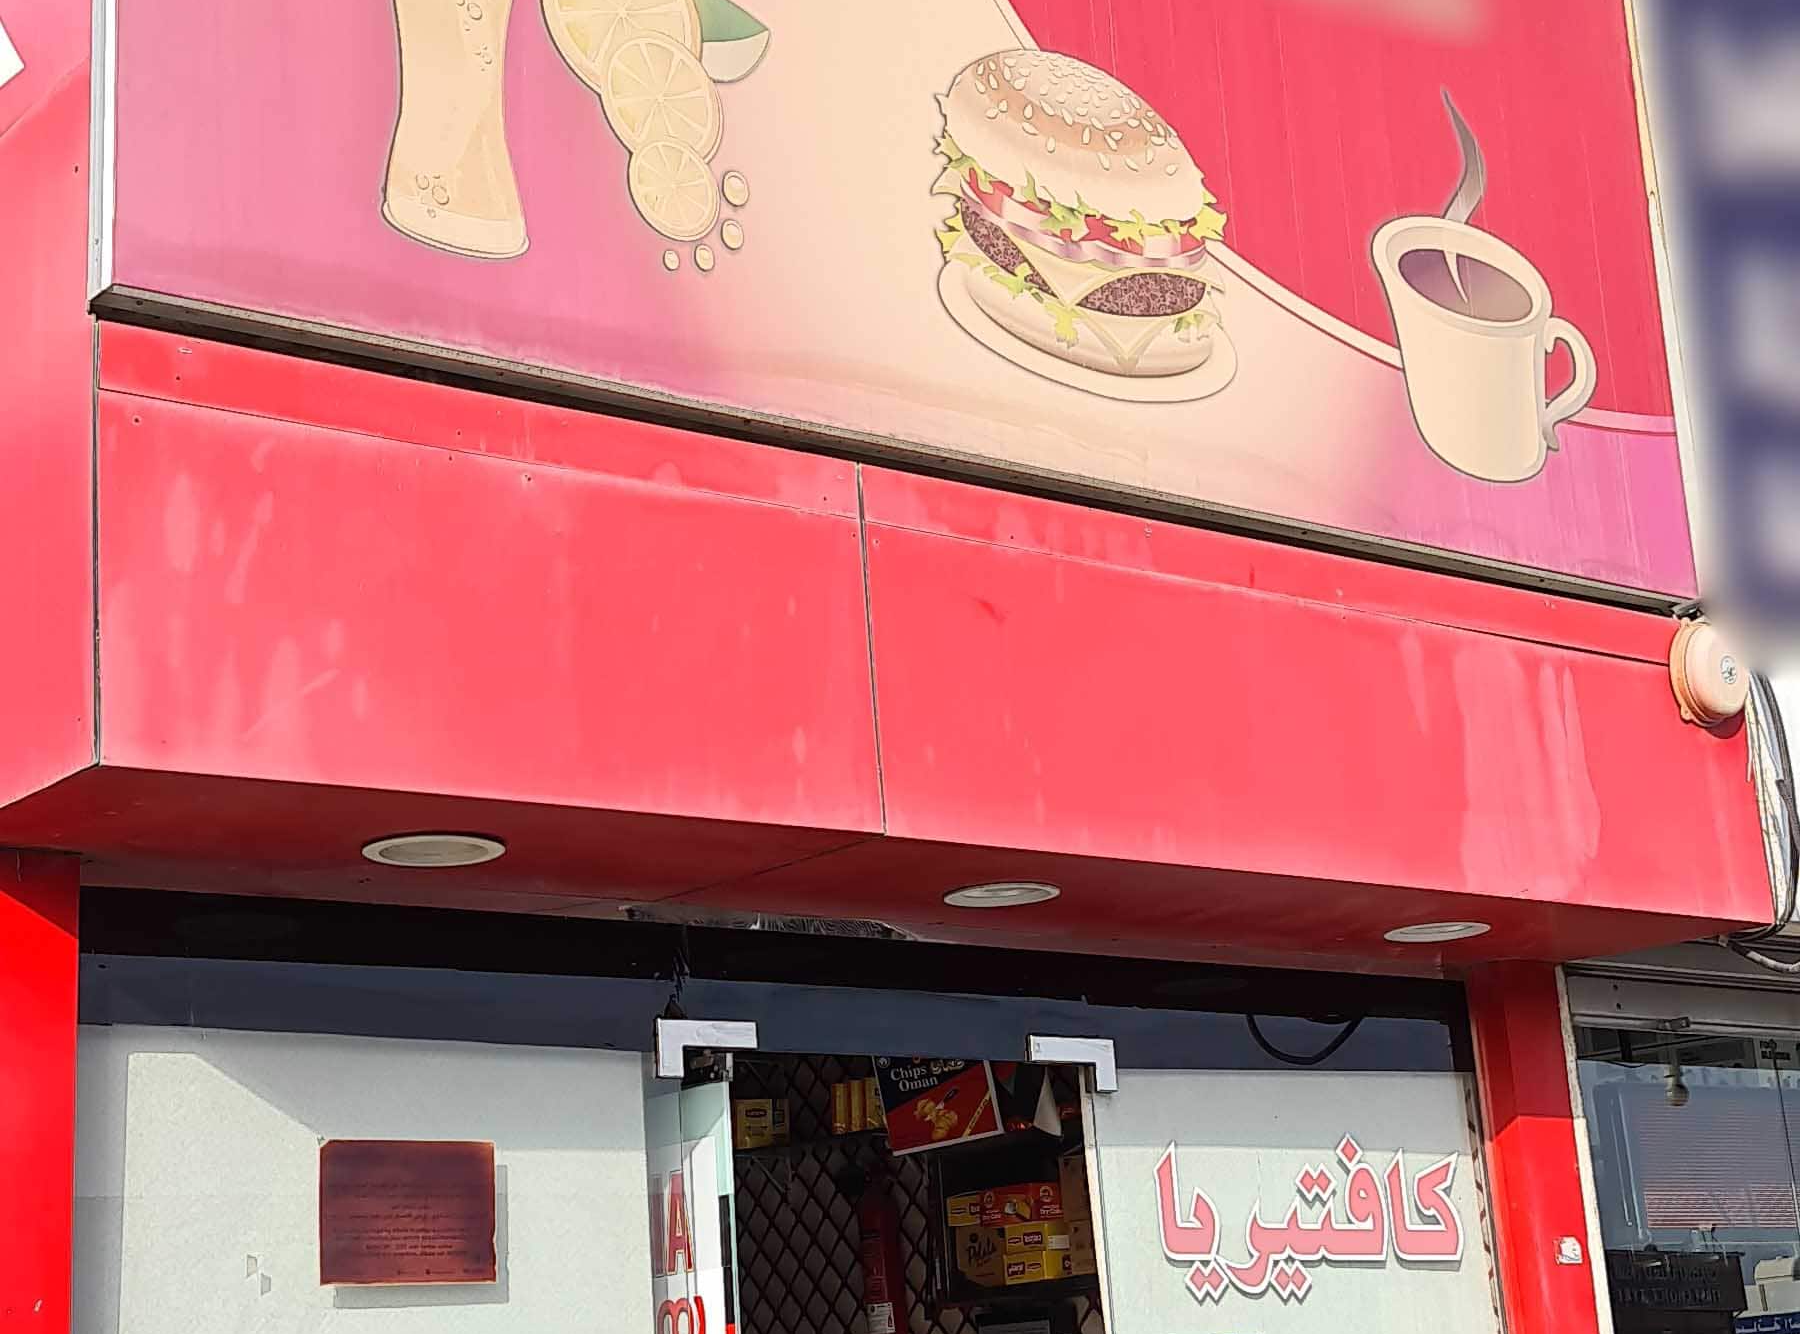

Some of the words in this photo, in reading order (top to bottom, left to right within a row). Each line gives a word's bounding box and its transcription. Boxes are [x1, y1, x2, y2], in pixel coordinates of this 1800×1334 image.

[890, 1065, 927, 1082] Chips
[899, 1075, 938, 1092] Oman
[1153, 1133, 1466, 1304] كافتيريا
